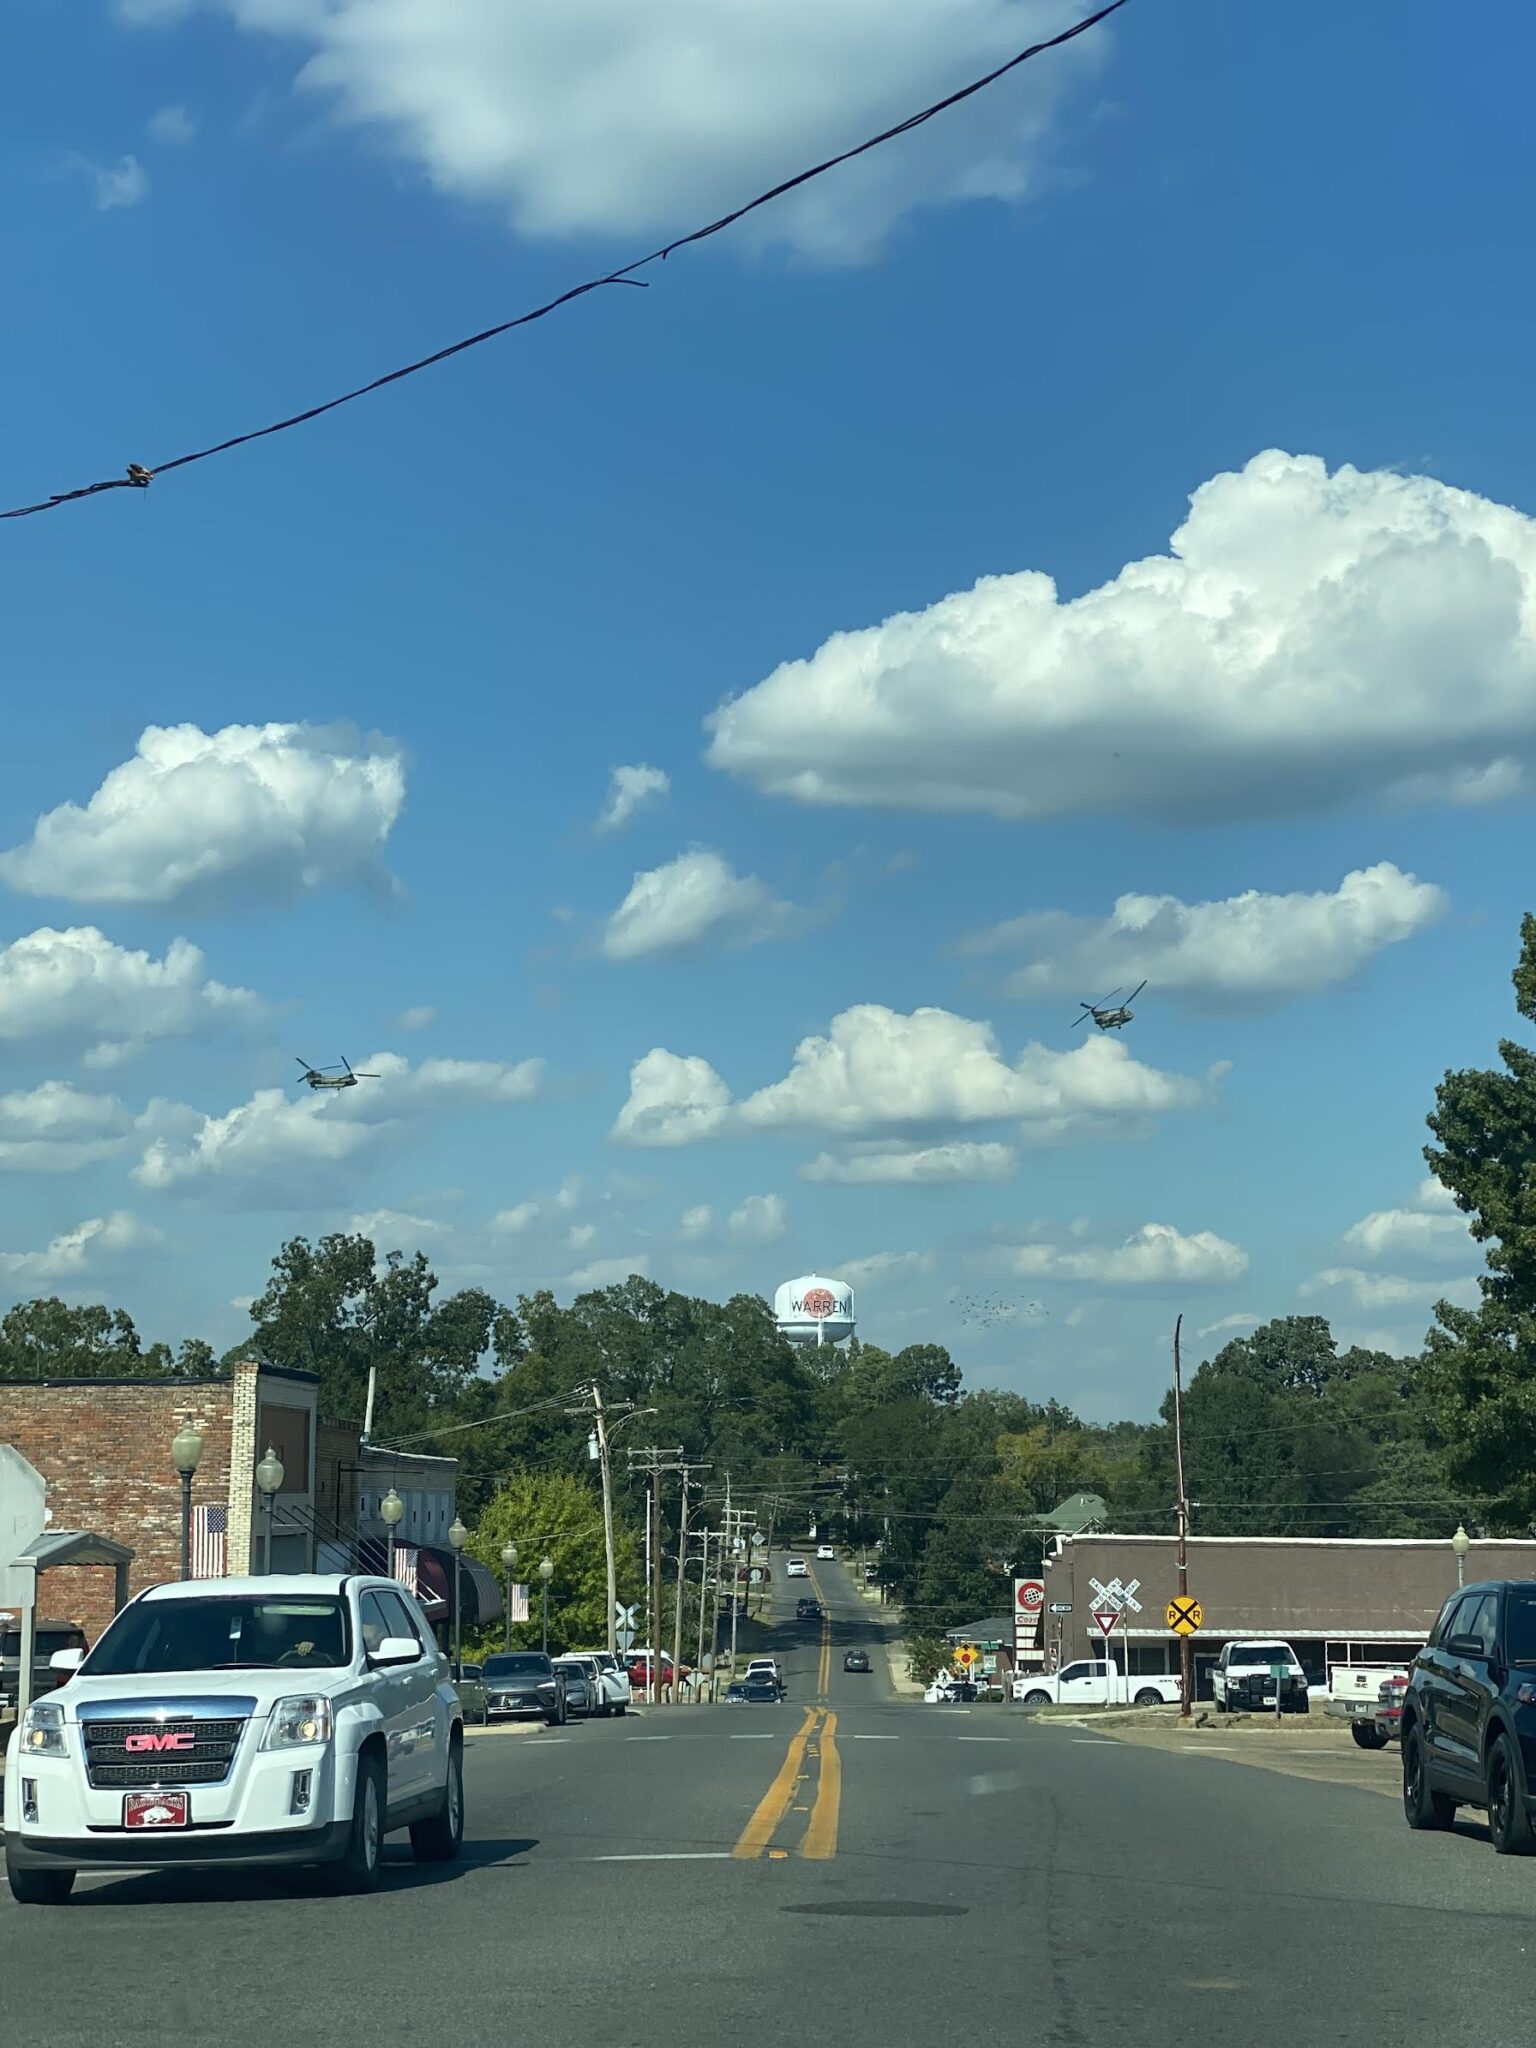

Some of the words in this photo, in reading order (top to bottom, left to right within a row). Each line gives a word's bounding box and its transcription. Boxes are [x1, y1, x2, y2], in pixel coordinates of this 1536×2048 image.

[792, 1300, 847, 1314] WARREN
[1169, 1610, 1176, 1619] R
[1193, 1610, 1200, 1619] R
[126, 1733, 195, 1751] GMC
